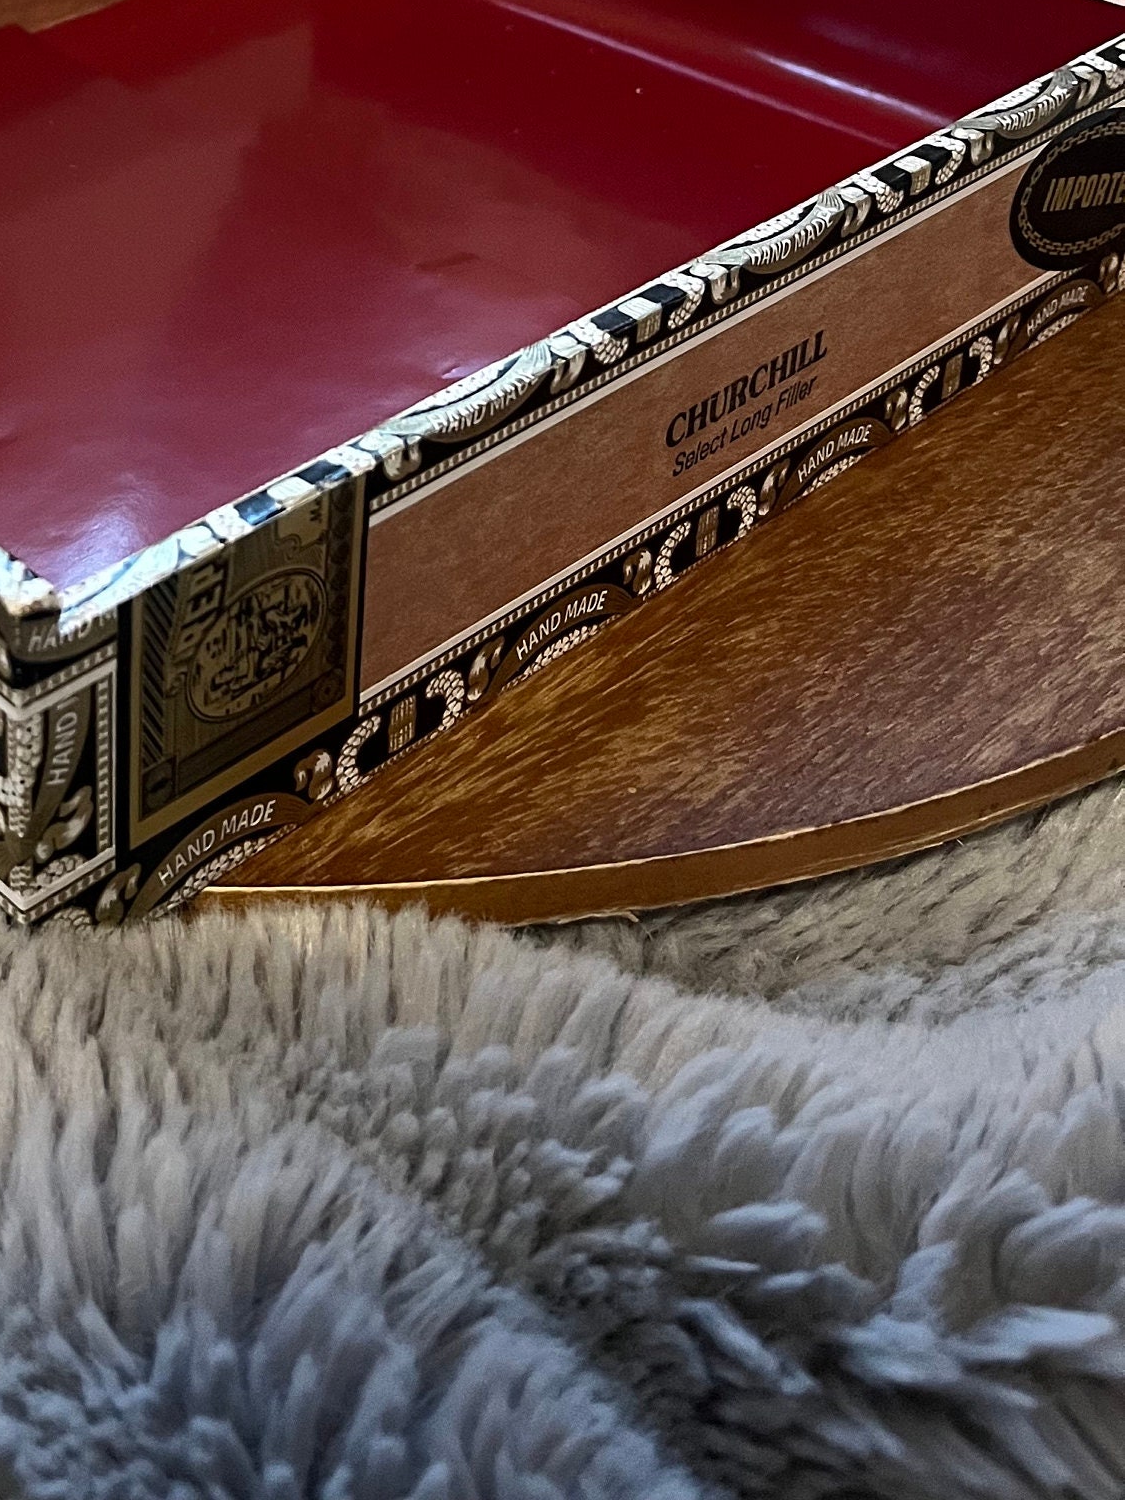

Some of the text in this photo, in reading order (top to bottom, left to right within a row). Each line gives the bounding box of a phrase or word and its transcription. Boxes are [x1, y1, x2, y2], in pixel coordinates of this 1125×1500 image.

[994, 87, 1072, 132] HAND MADE
[744, 211, 834, 266] HAND MADE
[1026, 298, 1058, 338] HAND
[665, 329, 828, 449] CHURCHILL
[672, 375, 819, 478] Select Long Filler
[797, 423, 873, 484] HAND MADE
[515, 589, 609, 661] HAND MADE
[46, 710, 79, 786] HAND
[157, 798, 277, 887] HAND MADE
